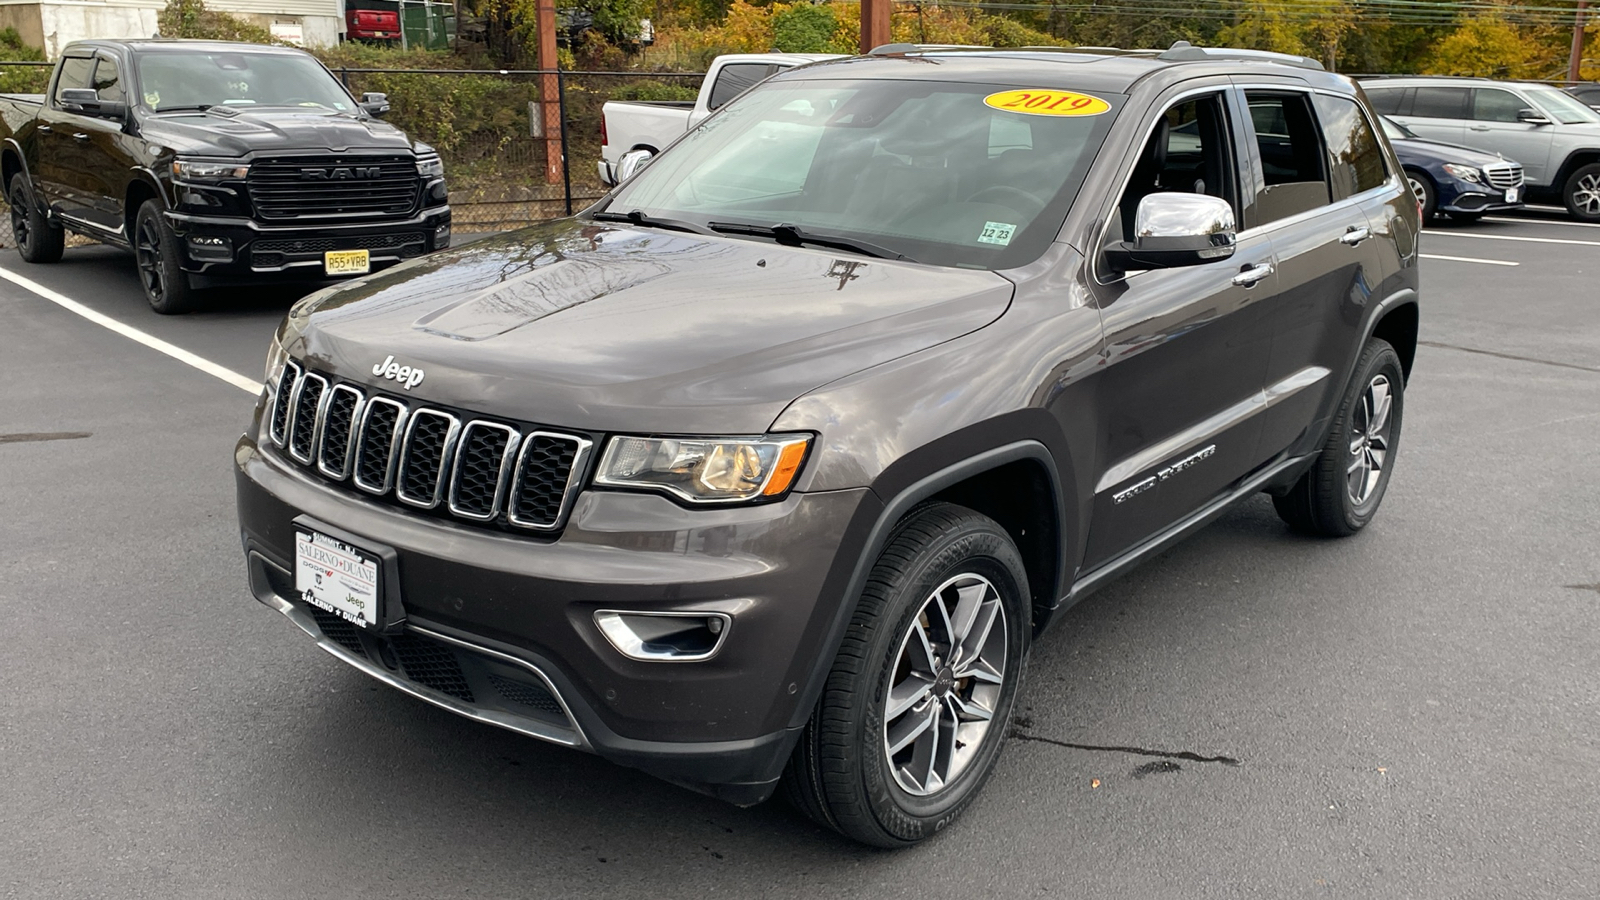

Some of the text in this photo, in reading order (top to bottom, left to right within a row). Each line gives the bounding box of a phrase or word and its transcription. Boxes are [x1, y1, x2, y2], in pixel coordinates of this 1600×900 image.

[1001, 93, 1092, 111] 2019
[300, 167, 381, 180] RAM
[981, 228, 1010, 240] 12 23
[328, 257, 346, 269] R55
[372, 354, 425, 391] Jeep
[298, 542, 339, 568] SALERNO
[343, 560, 375, 584] DUANE
[345, 592, 365, 610] Jeep
[301, 592, 367, 629] SALERNO DUANE
